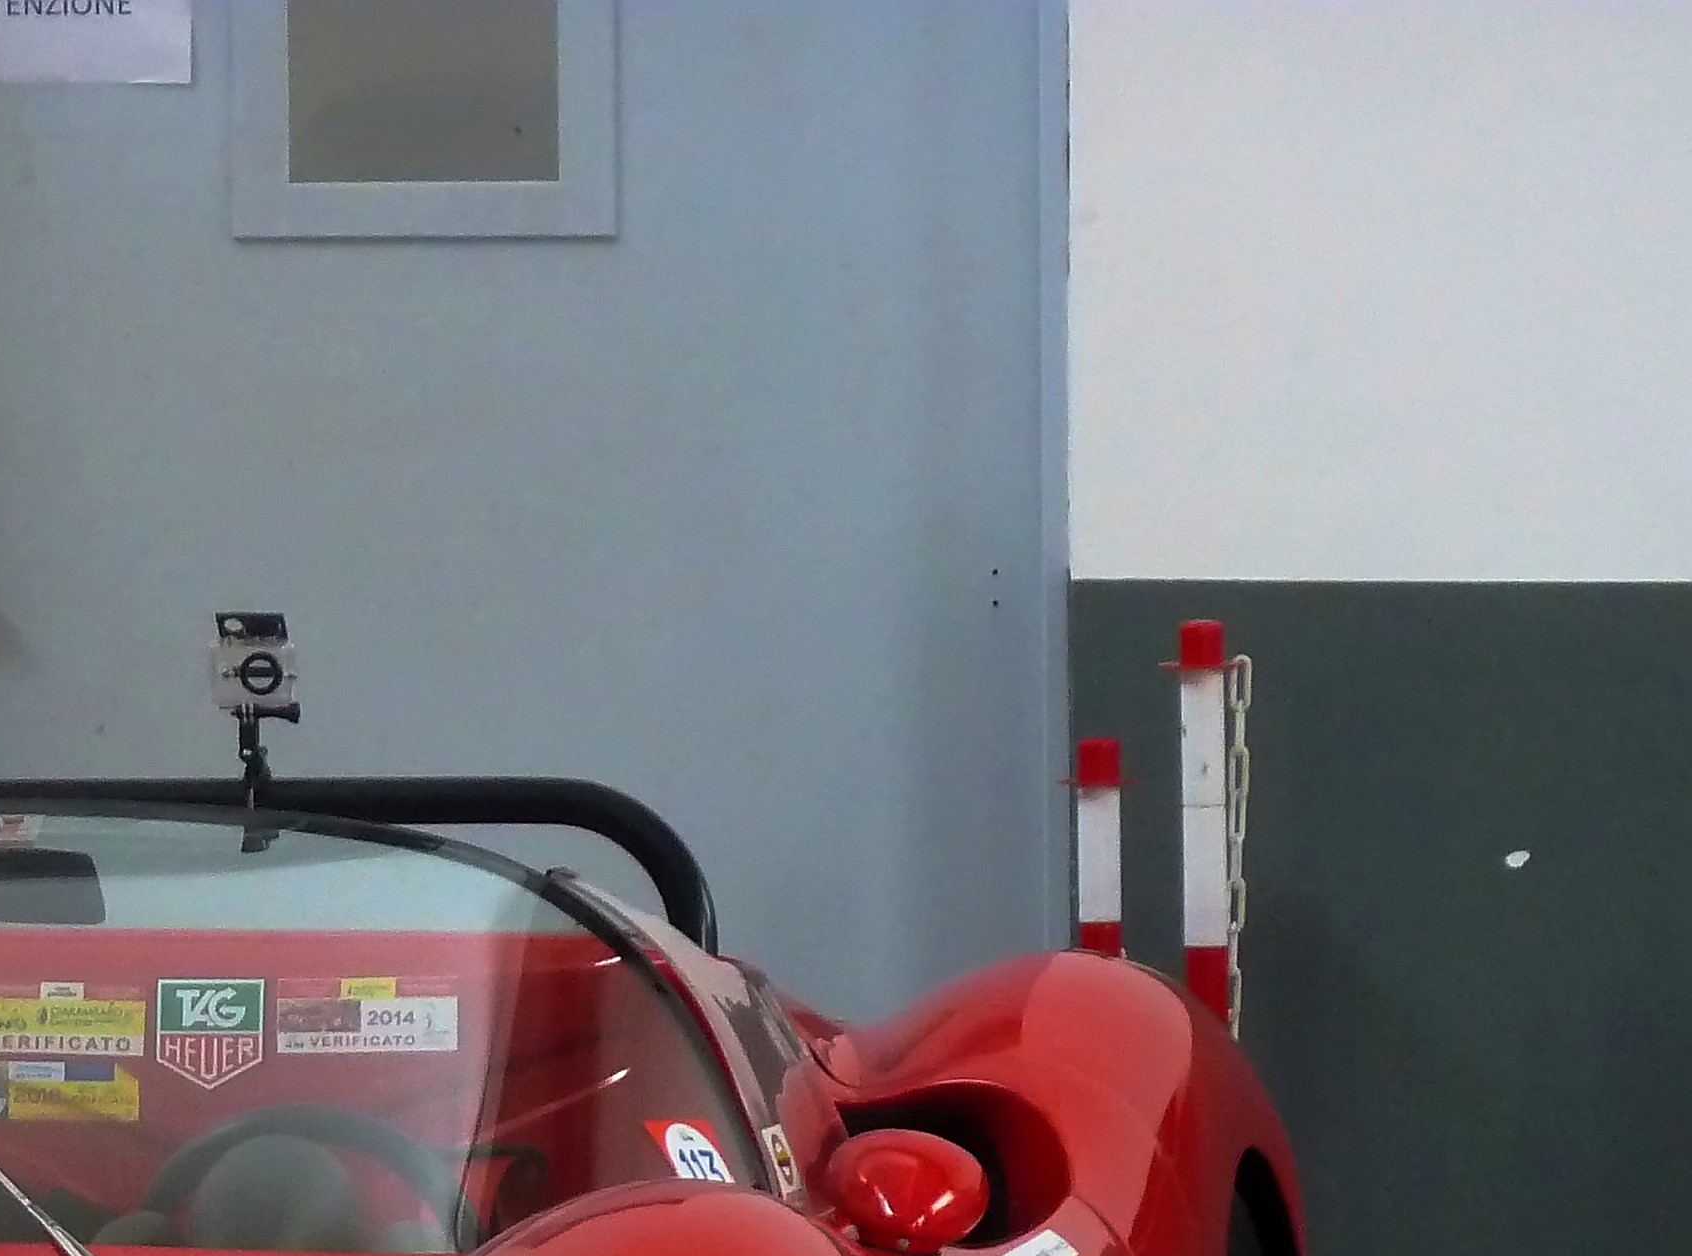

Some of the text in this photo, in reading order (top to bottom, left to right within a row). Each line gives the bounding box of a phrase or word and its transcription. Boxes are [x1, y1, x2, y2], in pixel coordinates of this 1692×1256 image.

[175, 987, 246, 1028] TAG
[366, 1009, 417, 1027] 2014
[308, 1034, 417, 1049] VERIFICATO
[165, 1037, 254, 1080] HEUER
